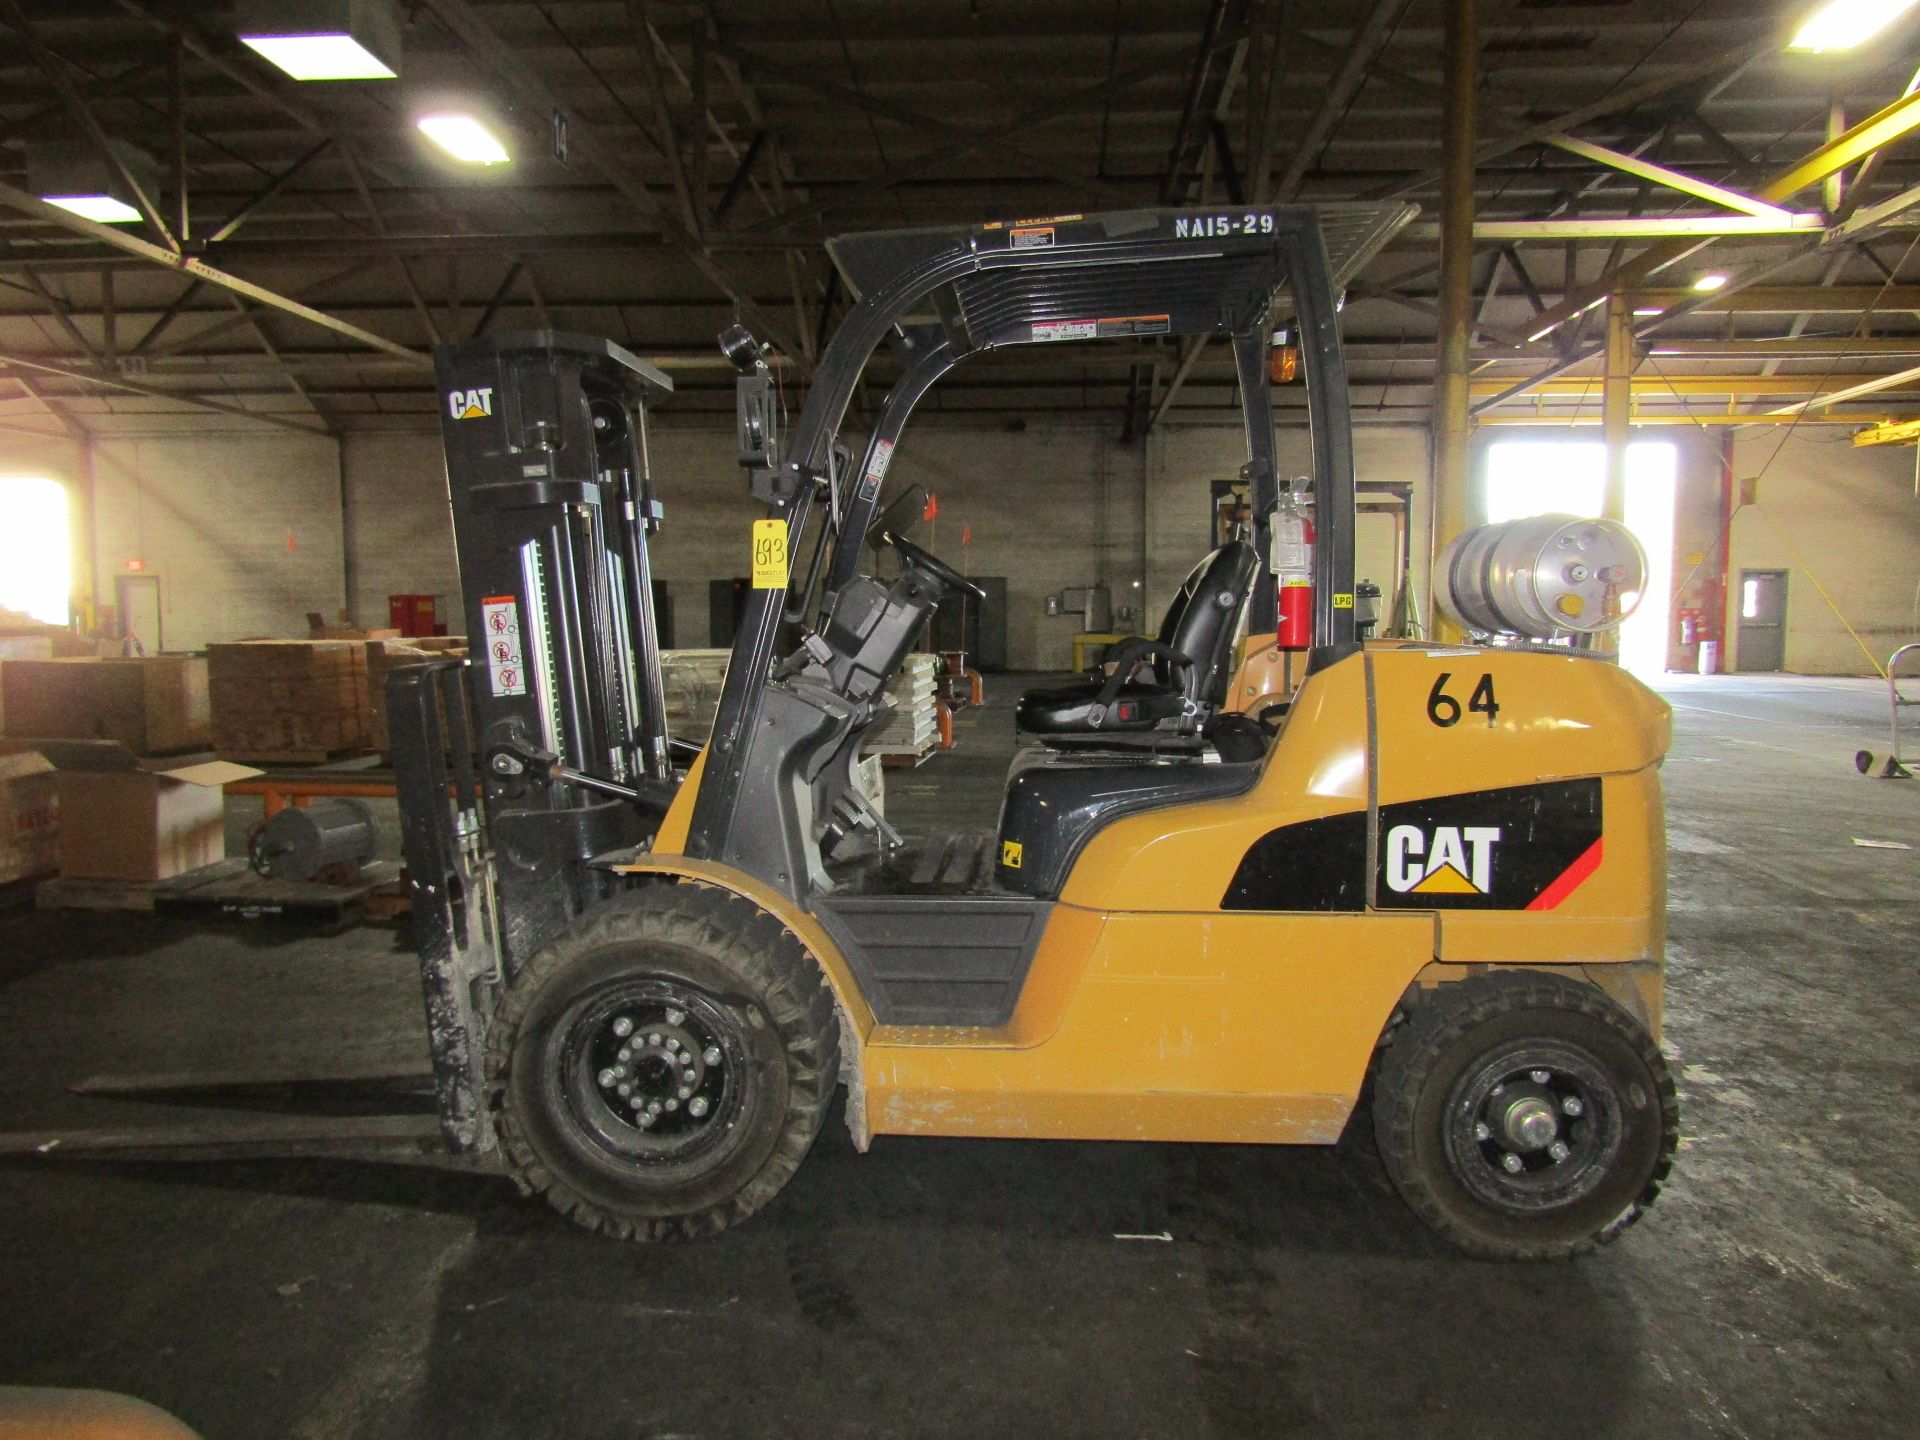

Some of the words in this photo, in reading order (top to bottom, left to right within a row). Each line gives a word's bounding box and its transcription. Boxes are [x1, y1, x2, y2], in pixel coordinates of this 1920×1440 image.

[449, 387, 493, 420] CAT
[755, 537, 785, 566] 693
[1334, 596, 1351, 605] LPG
[1427, 672, 1500, 729] 64
[1386, 824, 1500, 894] CAT
